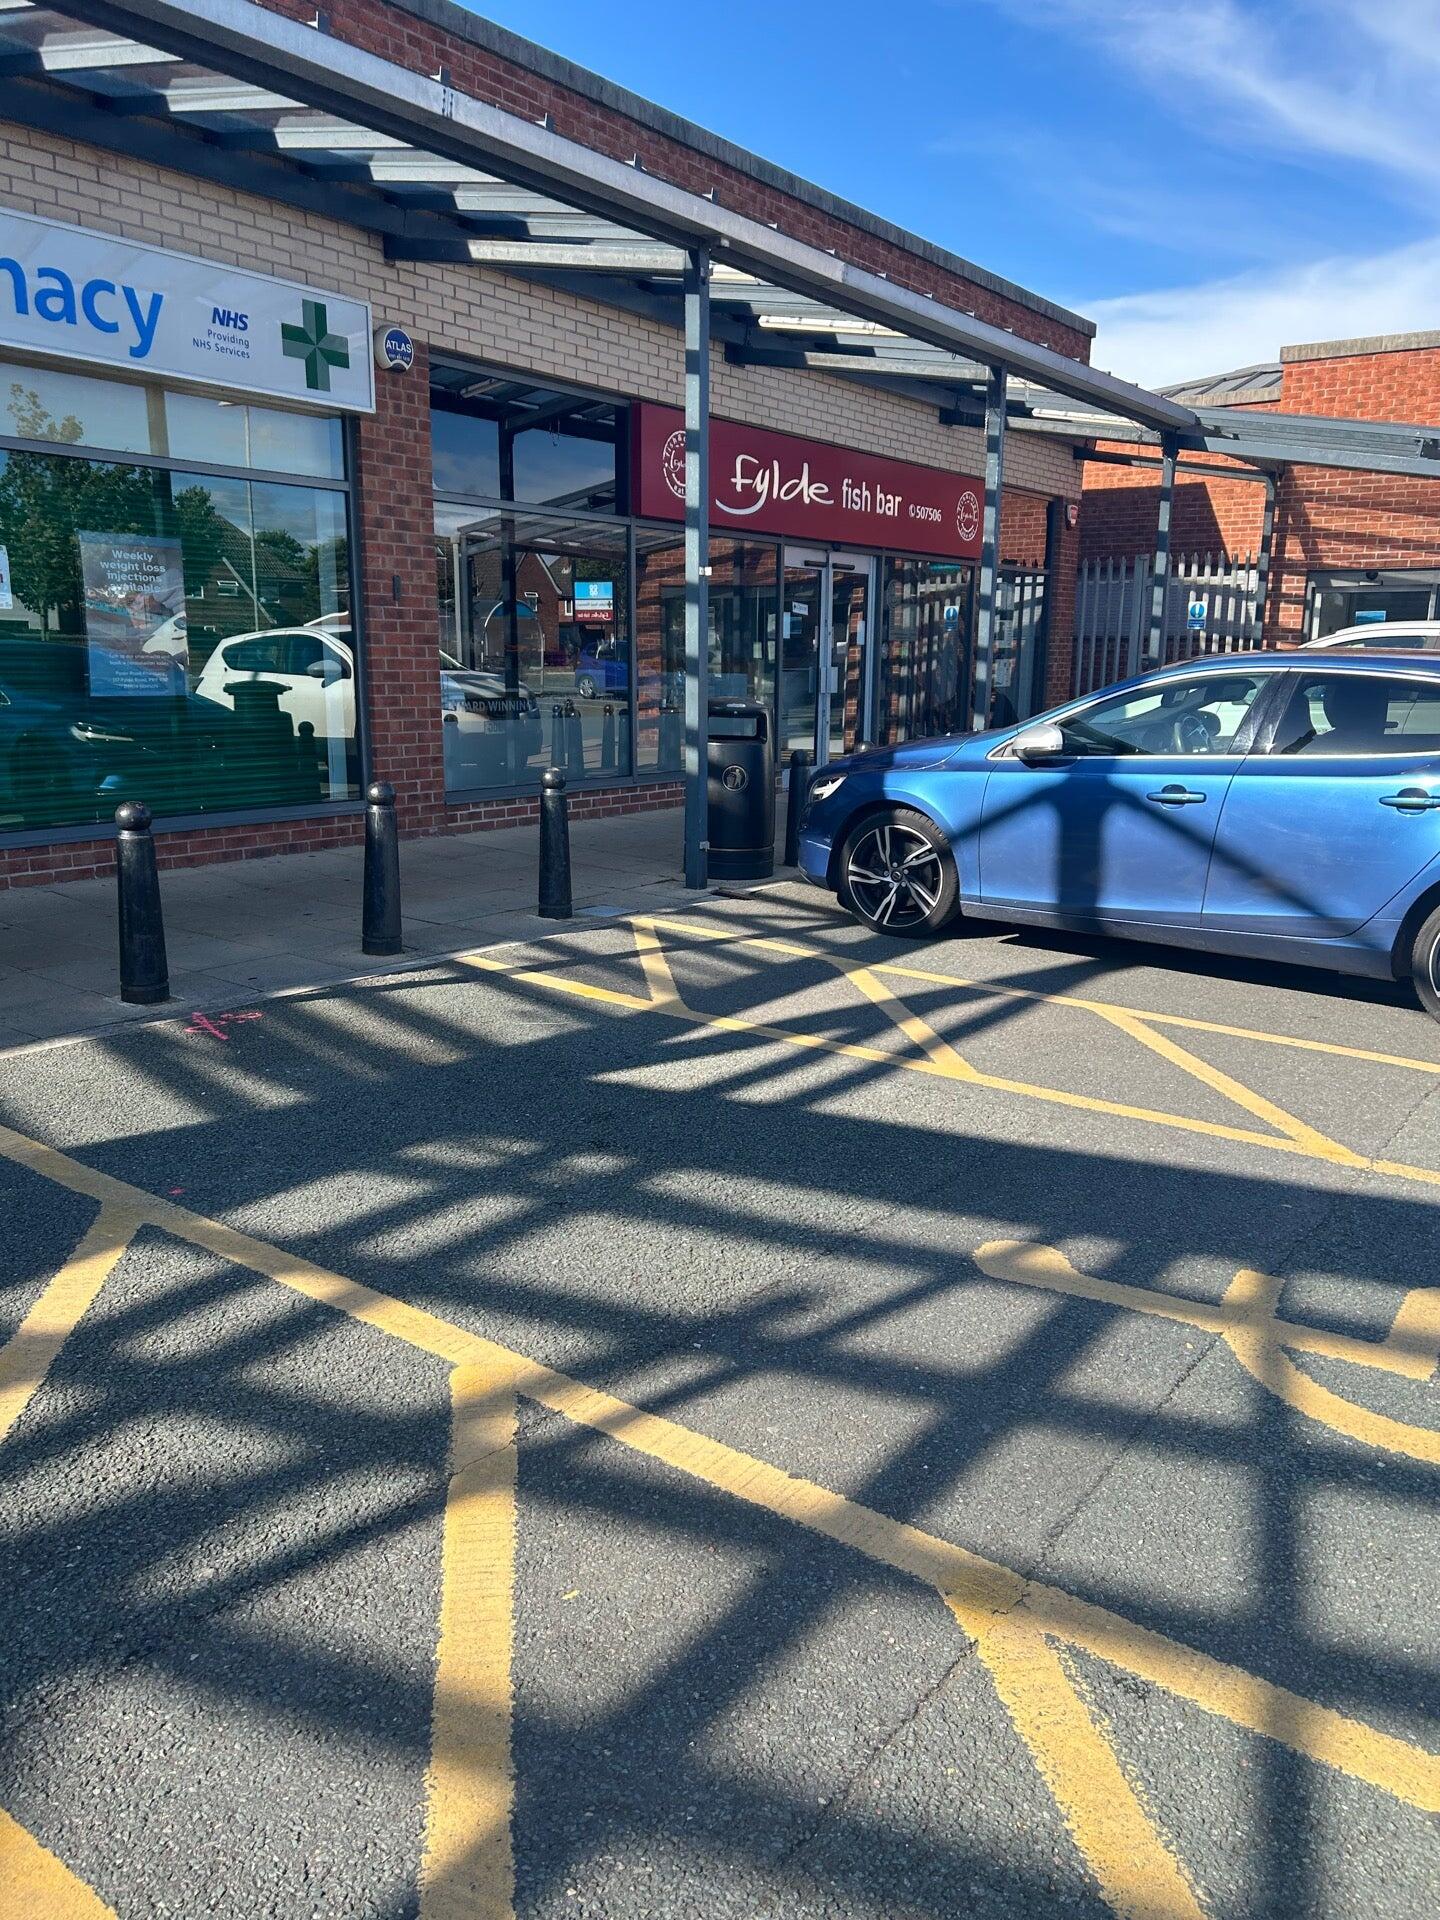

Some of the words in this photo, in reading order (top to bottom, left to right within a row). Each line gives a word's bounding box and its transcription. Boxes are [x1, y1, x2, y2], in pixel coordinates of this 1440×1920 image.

[211, 306, 249, 331] NHS
[207, 328, 250, 350] Providing
[192, 337, 212, 351] NHS
[214, 342, 250, 359] Services
[386, 339, 412, 354] ATLAS
[842, 477, 872, 513] fish
[876, 484, 903, 517] bar
[915, 505, 943, 523] 507506
[111, 549, 154, 563] Weekly
[99, 560, 140, 572] weight
[142, 563, 166, 573] loss
[106, 570, 162, 583] injections
[110, 582, 161, 593] available
[448, 700, 486, 713] AWARD
